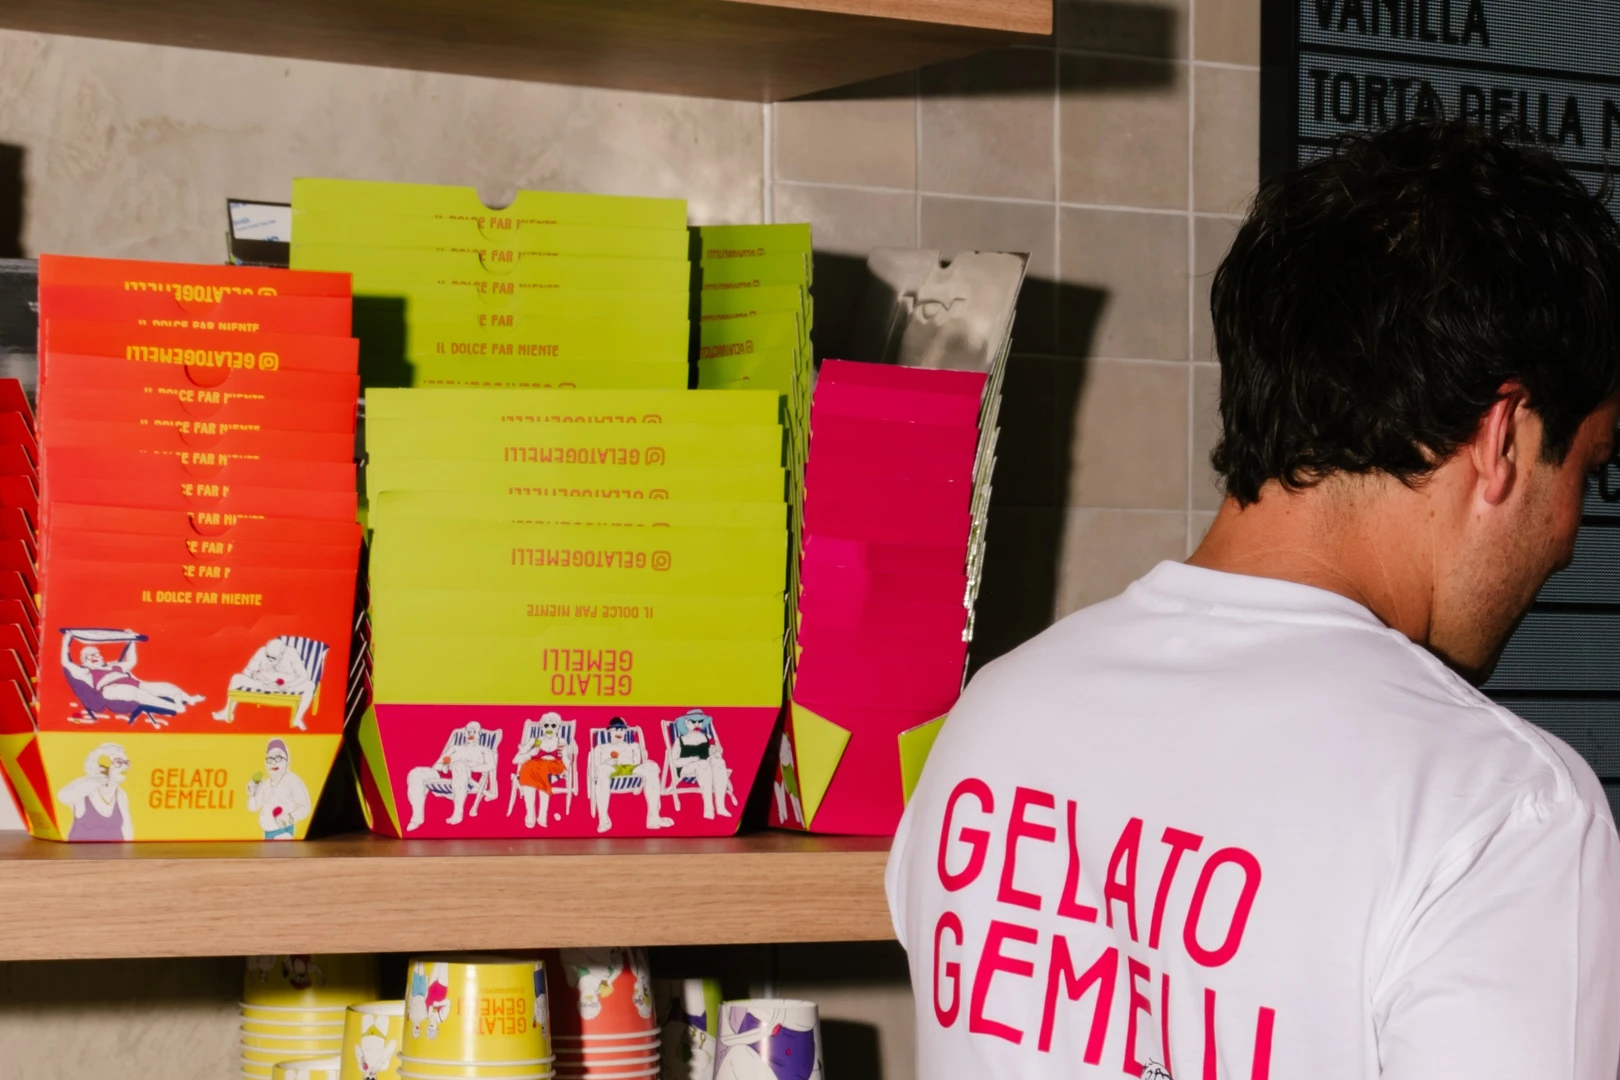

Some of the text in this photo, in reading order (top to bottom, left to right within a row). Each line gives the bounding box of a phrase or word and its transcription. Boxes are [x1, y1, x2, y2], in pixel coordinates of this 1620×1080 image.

[436, 342, 559, 357] IL DOLCE FAR NIENTE
[504, 447, 640, 466] GELATOGEMELLI
[511, 548, 647, 569] GELATOGEMELLI
[142, 590, 262, 606] IL DOLCE FAR NIENTE
[527, 604, 653, 619] IL DOLCE FAR NIENTE
[542, 648, 633, 673] GEMELLI
[551, 673, 633, 697] GELATO
[150, 768, 228, 788] GELATO
[149, 789, 234, 809] GEMELLI
[937, 777, 1262, 968] GELATO
[471, 1016, 527, 1035] GELAT
